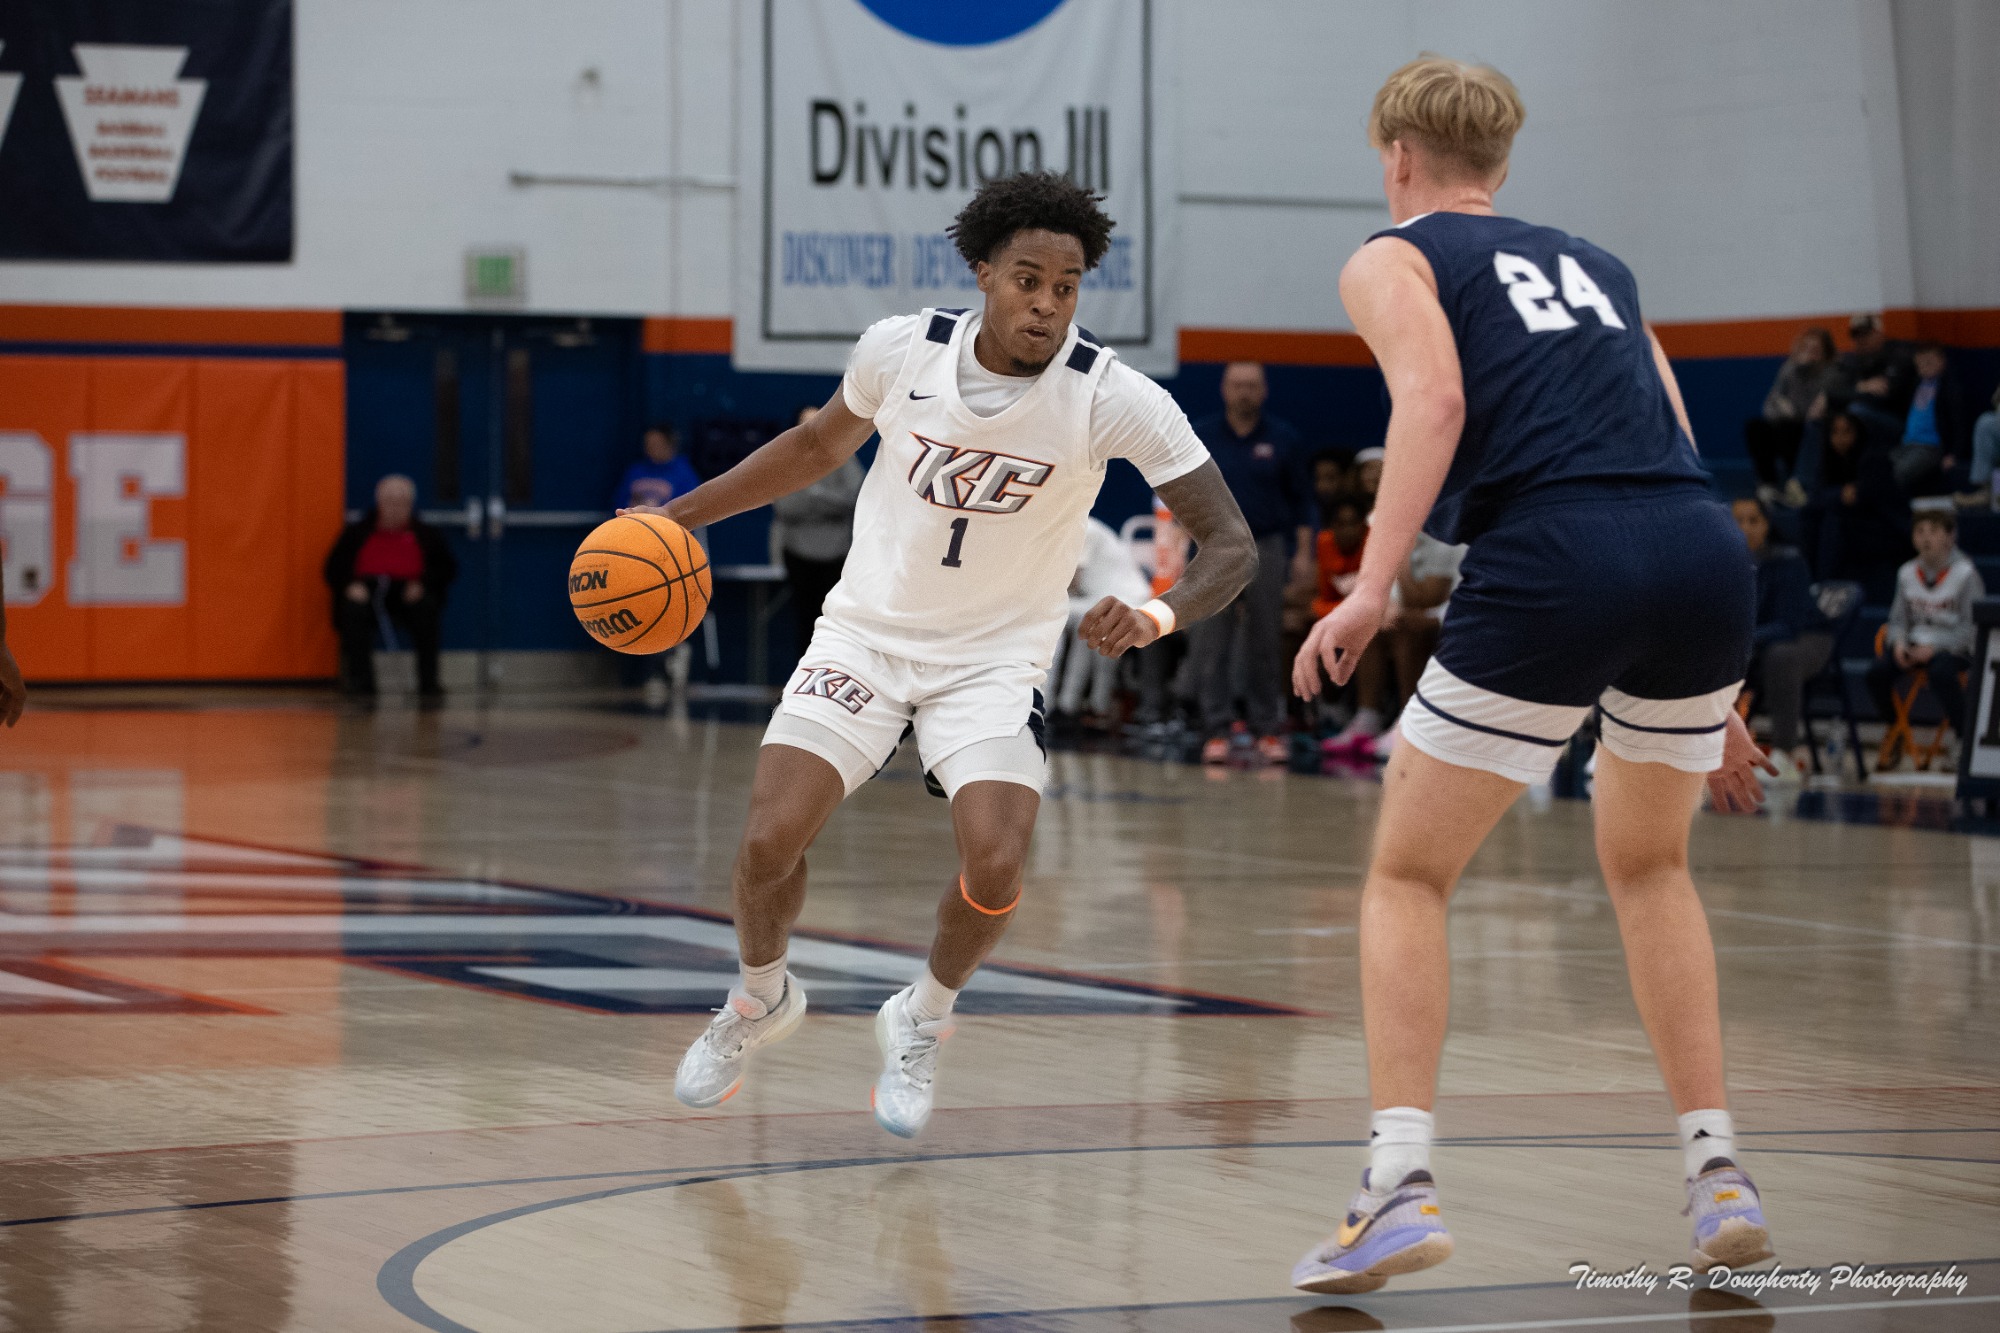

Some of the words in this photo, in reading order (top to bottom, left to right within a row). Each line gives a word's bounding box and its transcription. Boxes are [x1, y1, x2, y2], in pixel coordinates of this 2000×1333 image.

[811, 100, 1042, 190] Division
[783, 232, 894, 288] DISCOVER
[1493, 251, 1627, 333] 24
[908, 431, 1056, 514] KC
[941, 517, 969, 568] 1
[580, 608, 643, 639] Wils
[793, 667, 875, 715] KC
